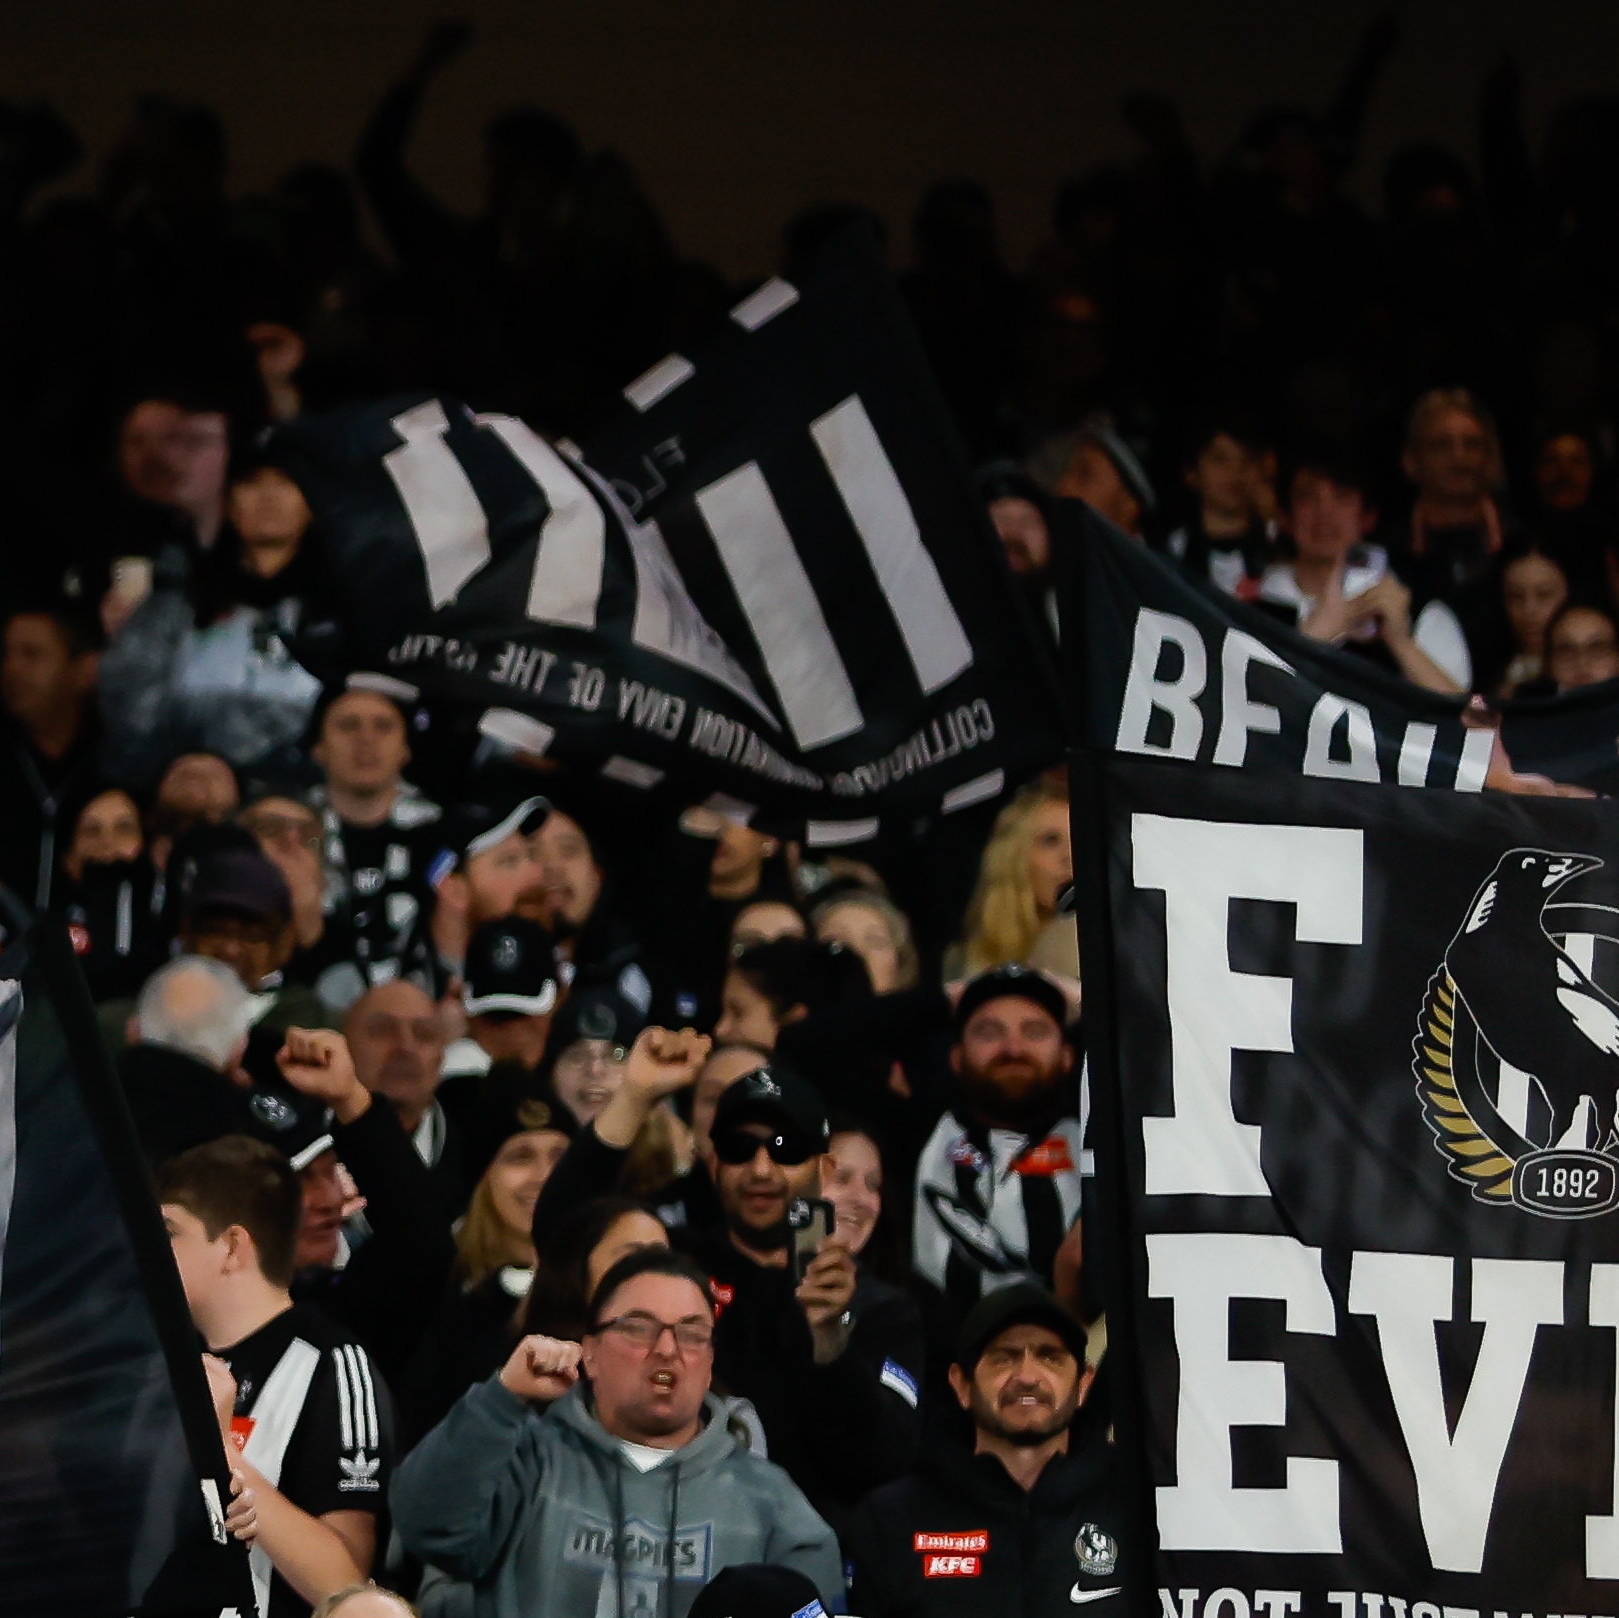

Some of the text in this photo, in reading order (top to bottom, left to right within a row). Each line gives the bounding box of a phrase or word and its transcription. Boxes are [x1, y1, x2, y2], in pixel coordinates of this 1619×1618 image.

[1537, 1165, 1599, 1202] 1892
[1145, 1233, 1619, 1581] EV
[917, 1534, 987, 1551] Emirates
[929, 1556, 977, 1576] KFC
